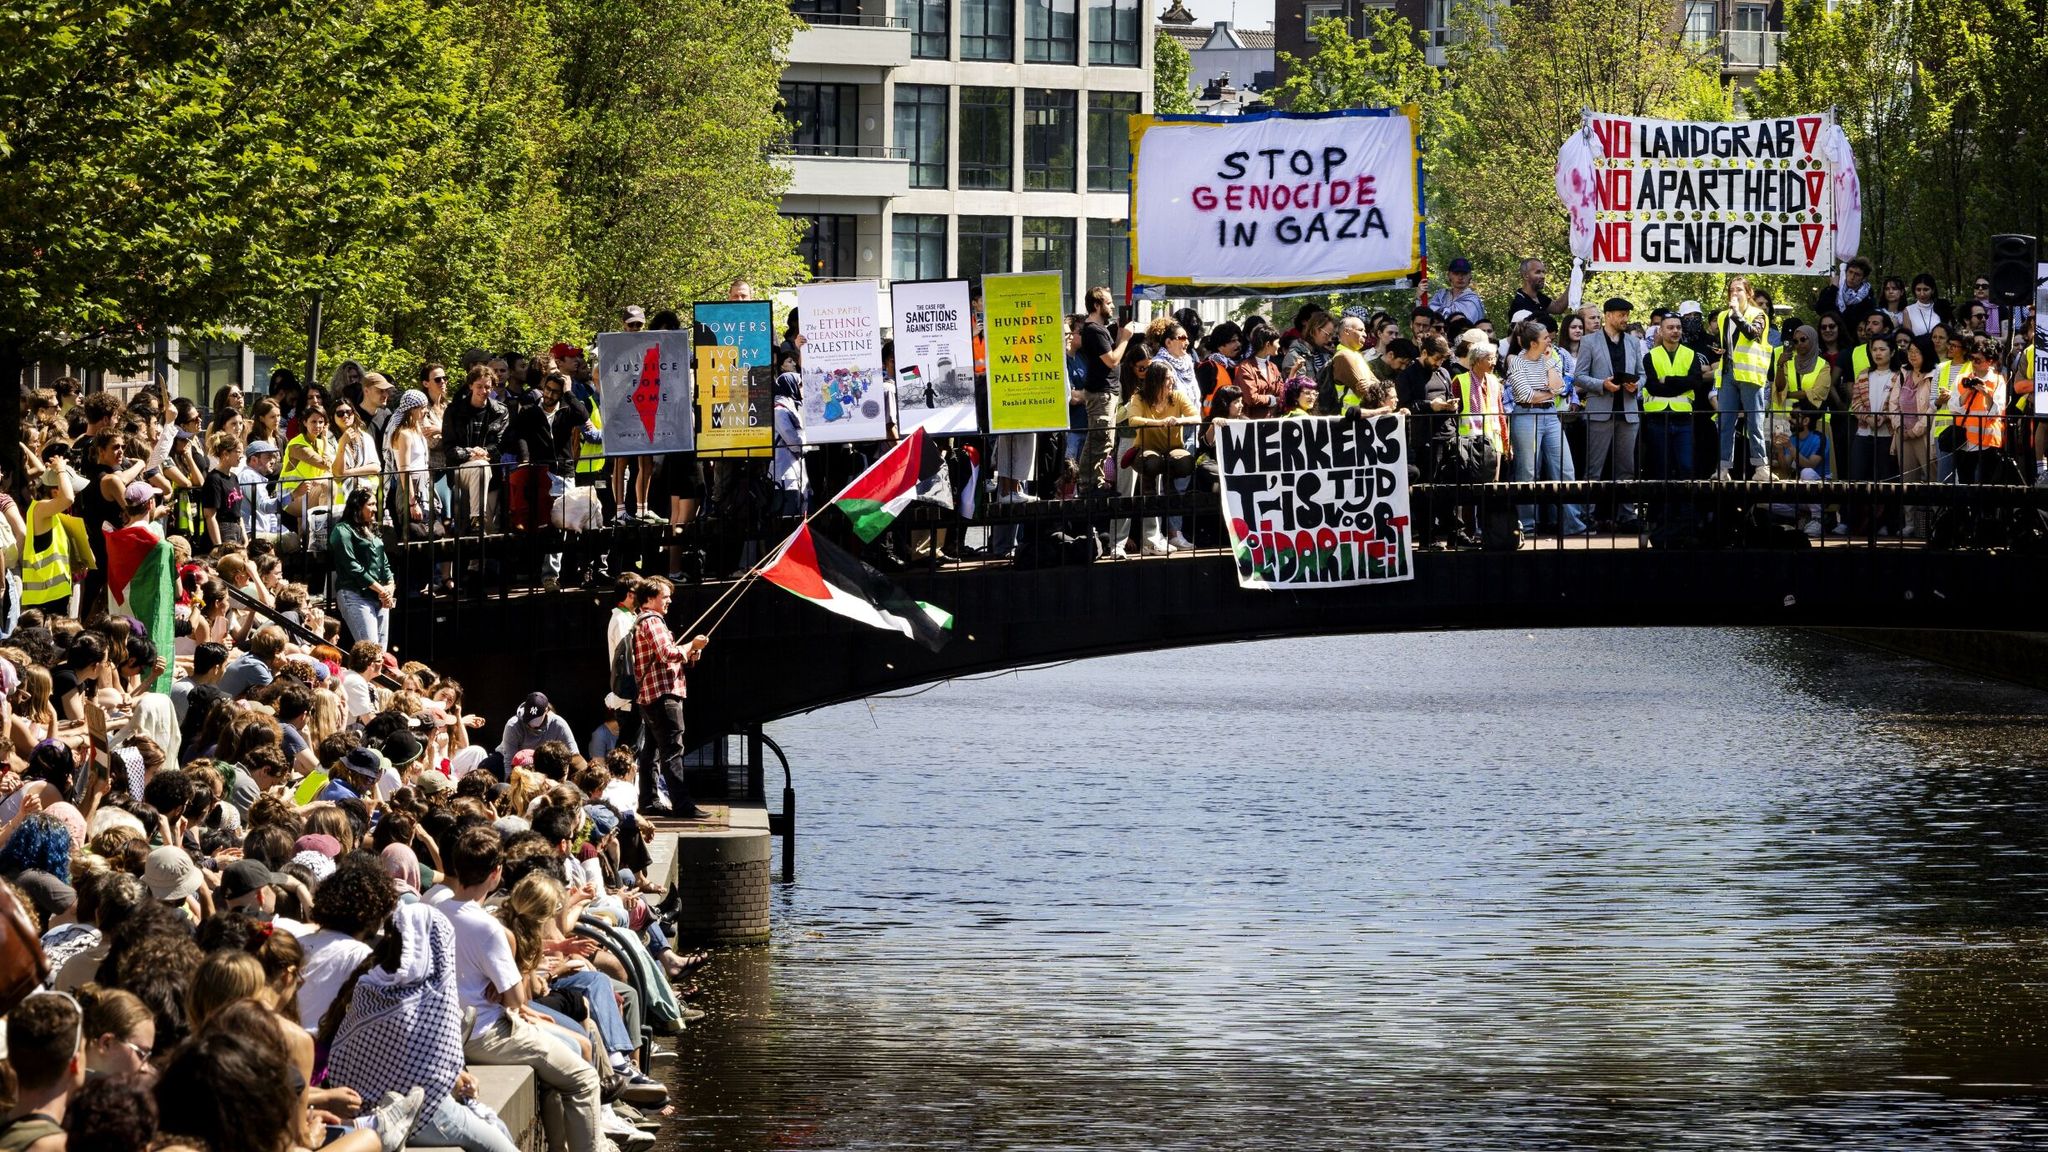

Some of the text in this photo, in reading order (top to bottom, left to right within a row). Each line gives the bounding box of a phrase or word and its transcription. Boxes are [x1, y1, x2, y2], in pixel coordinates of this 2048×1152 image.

[1593, 119, 1632, 158] NO
[1217, 147, 1348, 184] STOP
[1191, 174, 1377, 212] GENOCIDE
[1595, 169, 1632, 211] NO
[1218, 206, 1390, 248] IN GAZA
[1593, 222, 1632, 262] NO
[905, 309, 957, 323] SANCTIONS
[994, 315, 1054, 327] HUNDRED
[700, 321, 767, 333] TOWERS
[819, 316, 870, 330] ETHNIC
[906, 322, 958, 333] AGAINST ISRAEL
[724, 335, 744, 346] OF
[806, 329, 863, 340] CLEANSING
[807, 339, 873, 353] PALESTINE
[710, 348, 759, 360] IVORY
[1000, 352, 1052, 363] WAR ON
[613, 362, 678, 372] JUSTICE
[717, 362, 752, 373] AND
[632, 378, 661, 387] FOR
[712, 375, 758, 387] STEEL
[994, 371, 1060, 383] PALESTINE
[626, 393, 668, 403] SOME
[713, 402, 758, 413] MAYA
[712, 415, 758, 427] WIND
[1221, 415, 1401, 474] WERKERS
